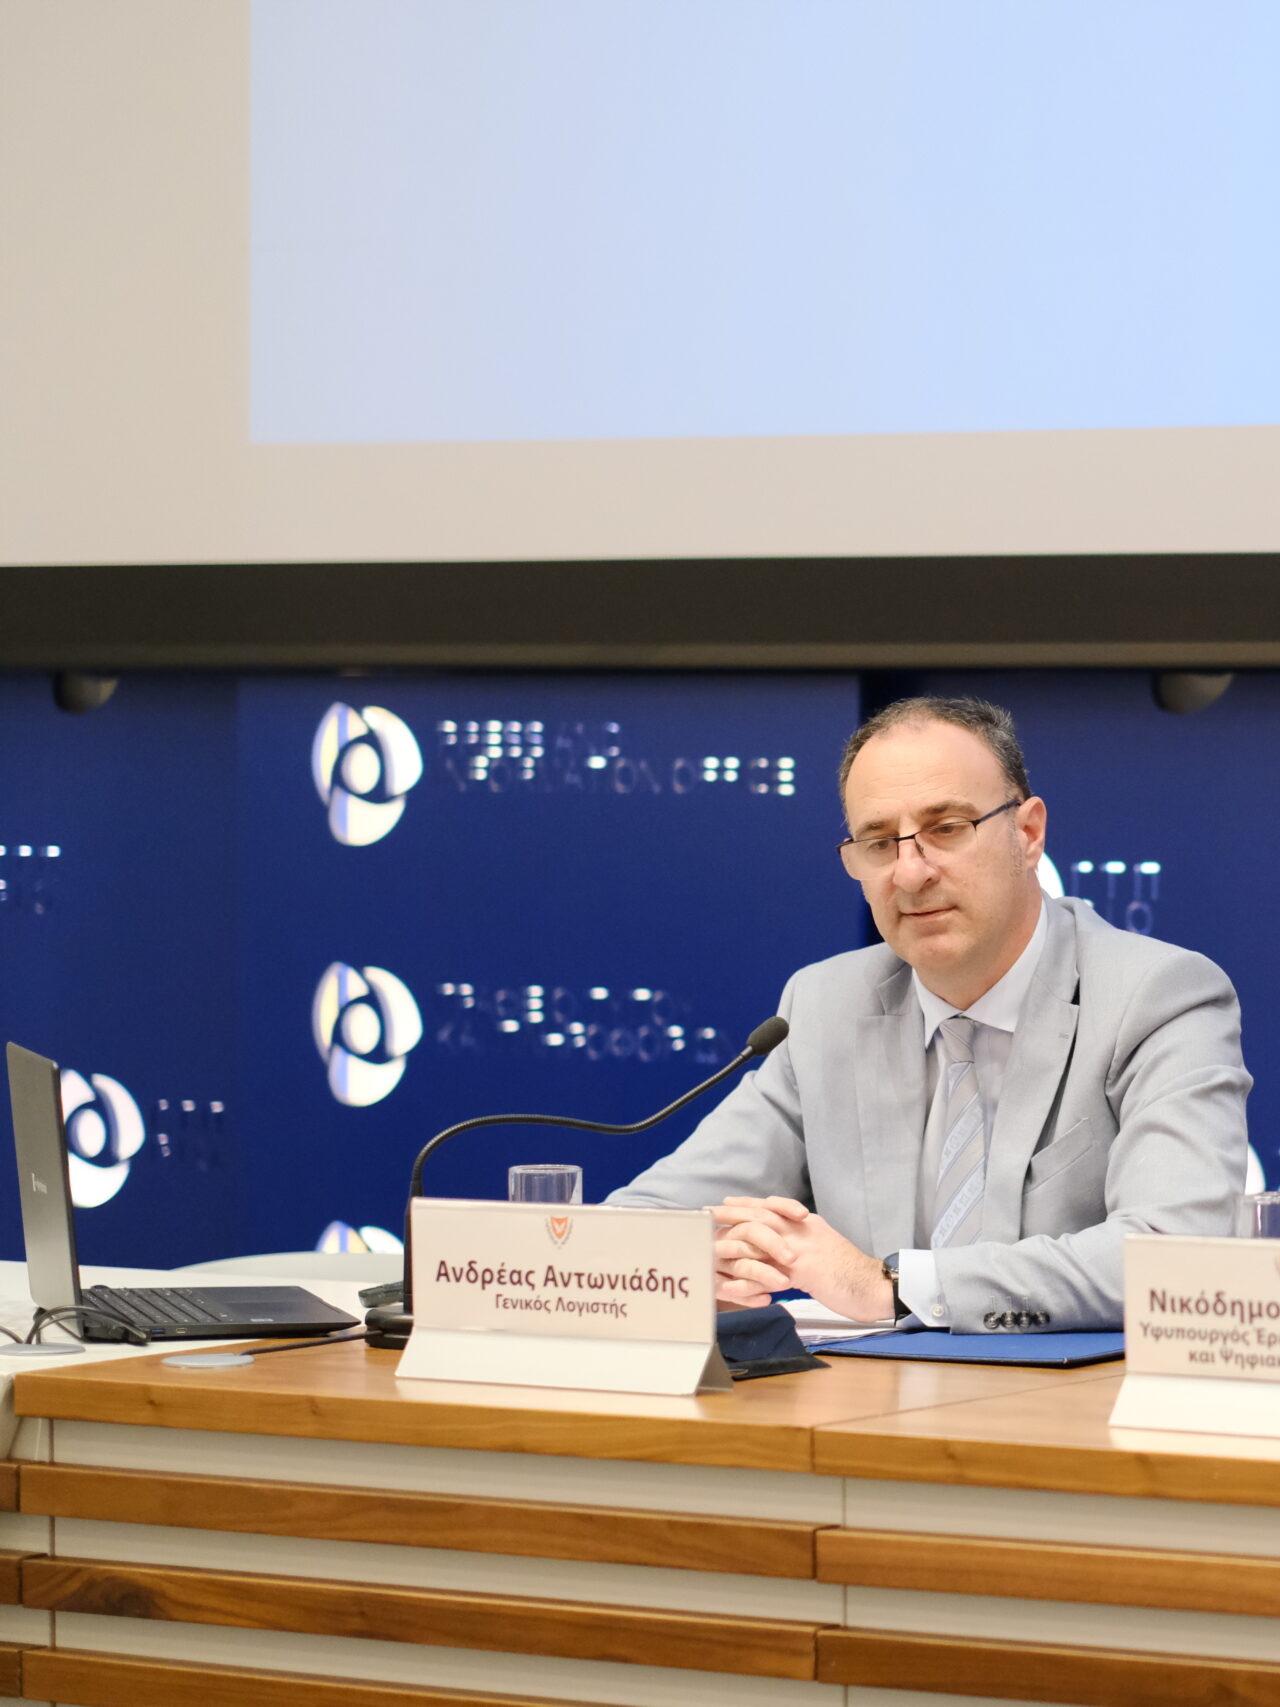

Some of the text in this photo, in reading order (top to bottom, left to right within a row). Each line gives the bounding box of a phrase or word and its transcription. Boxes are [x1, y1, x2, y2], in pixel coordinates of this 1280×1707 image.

[435, 1260, 690, 1299] Ανδρέας Αντωνιάδης
[495, 1293, 628, 1318] Γενικός Λογιστής
[1140, 1321, 1250, 1347] Υφυπουργός
[1188, 1350, 1215, 1364] και
